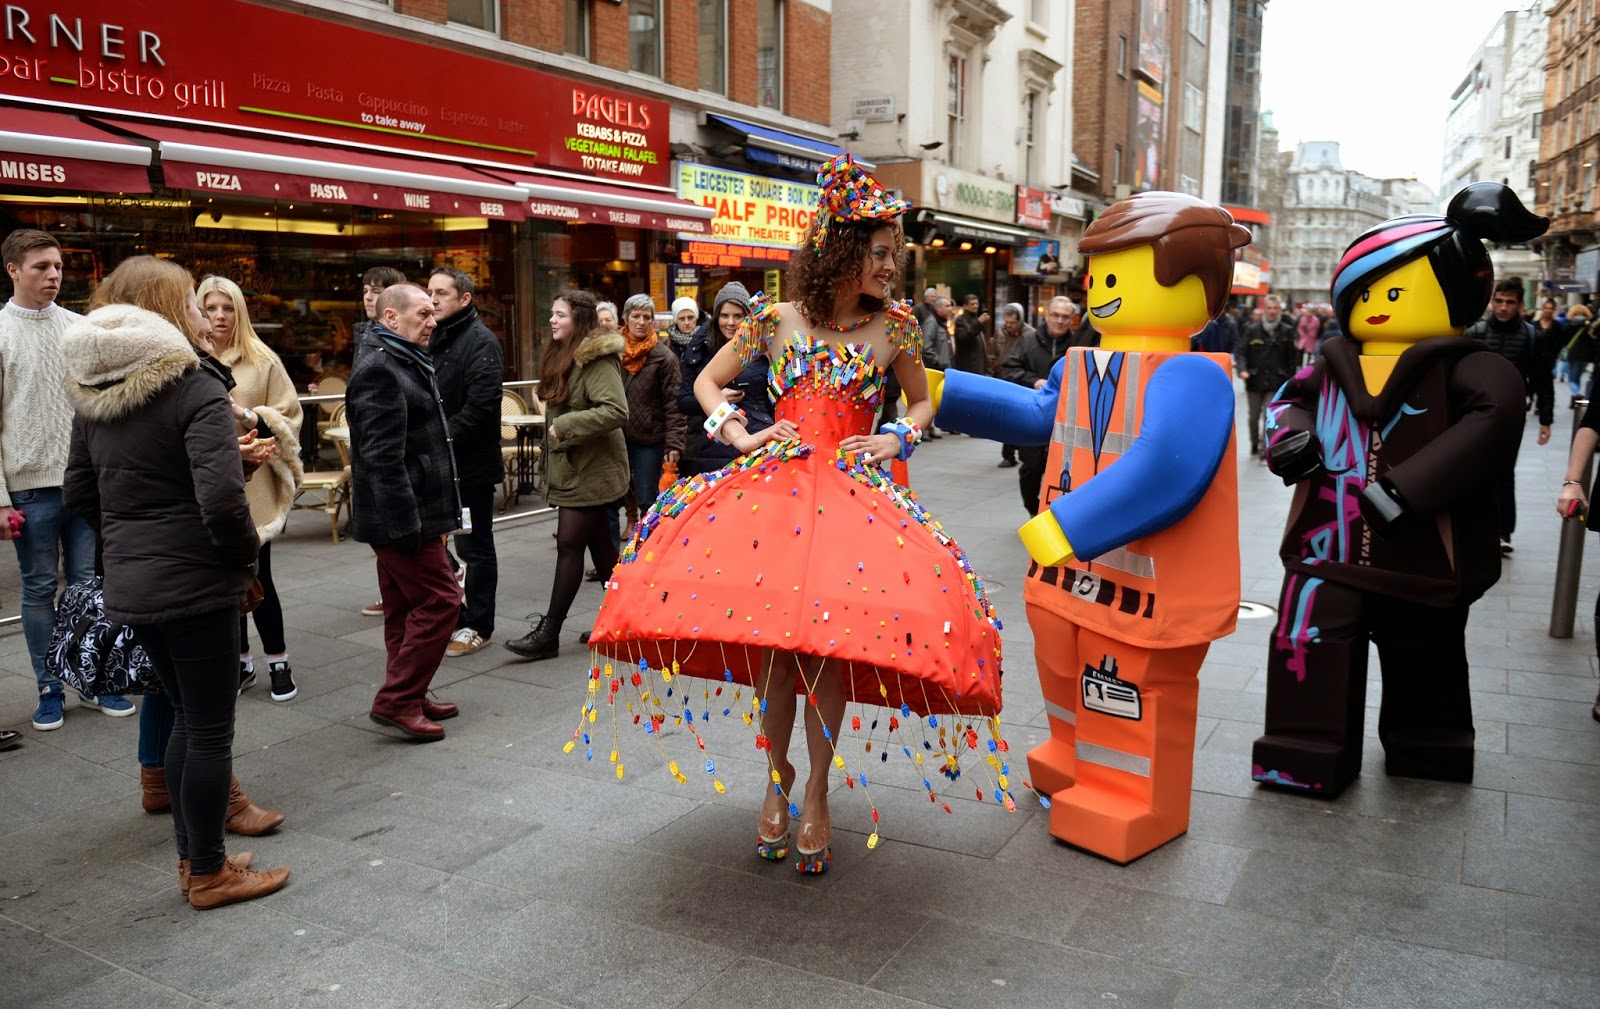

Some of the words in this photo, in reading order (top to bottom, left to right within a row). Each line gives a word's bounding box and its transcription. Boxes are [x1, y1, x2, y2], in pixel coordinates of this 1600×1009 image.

[5, 4, 166, 66] RNER
[79, 57, 164, 99] bistro
[174, 80, 226, 110] grill
[253, 73, 290, 93] Pizza
[307, 82, 344, 102] Pasta
[357, 92, 428, 117] Cappuccino
[440, 107, 488, 127] Espresso
[572, 89, 652, 130] BAGELS
[361, 112, 374, 124] to
[375, 115, 398, 128] take
[400, 120, 426, 134] away
[577, 122, 613, 142] KEBABS
[613, 129, 621, 143] &
[622, 131, 647, 147] PIZZA
[564, 137, 621, 158] VEGETARIAN
[624, 147, 658, 164] FALAFEL
[0, 160, 66, 183] MISES
[581, 155, 595, 170] TO
[595, 157, 618, 173] TAKE
[618, 161, 644, 176] AWAY
[196, 171, 242, 191] PIZZA
[310, 183, 347, 200] PASTA
[694, 170, 745, 195] LEICESTER
[749, 180, 783, 202] SQUARE
[788, 187, 803, 205] BOX
[404, 193, 430, 209] WINE
[480, 202, 505, 217] BEER
[531, 202, 579, 219] CAPPUCCINO
[609, 211, 624, 223] TAKE
[625, 213, 641, 225] AWAY
[666, 218, 704, 232] SANDWICHES
[747, 226, 790, 241] THEATRE
